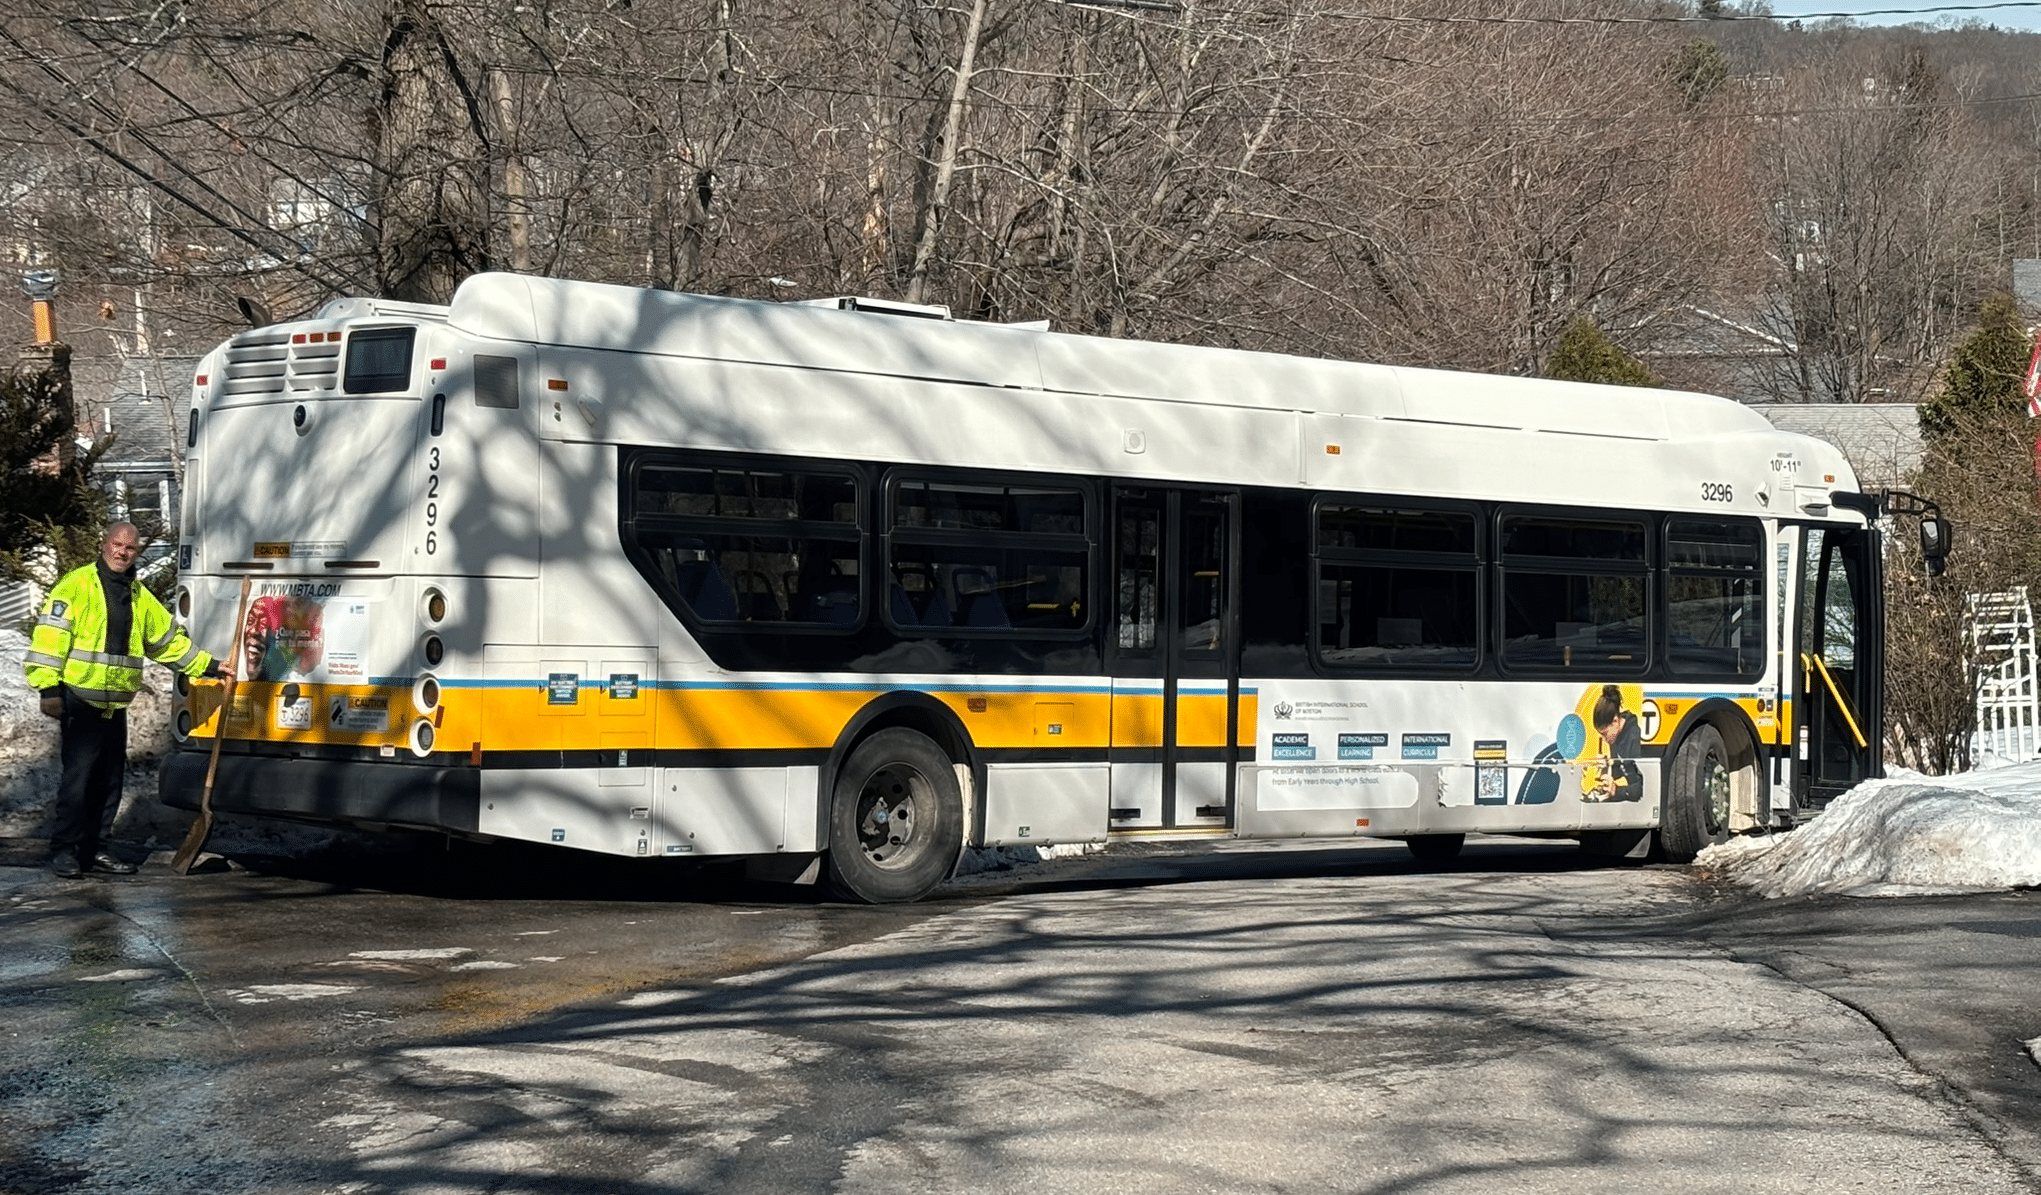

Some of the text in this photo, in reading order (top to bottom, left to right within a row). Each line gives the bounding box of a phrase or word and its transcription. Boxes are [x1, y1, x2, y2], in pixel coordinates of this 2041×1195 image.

[1701, 482, 1733, 503] 3296
[426, 446, 440, 556] 3296
[260, 583, 342, 597] WWW.MBTA.COM
[355, 698, 388, 708] CAUTION
[290, 707, 309, 722] 3296
[1642, 711, 1656, 735] T
[1273, 736, 1307, 744] ACADEMIC
[1339, 736, 1385, 744] PERSONALIZED
[1403, 736, 1449, 744] INTERNATIONAL
[1272, 749, 1312, 757] EXCELLENCE
[1340, 749, 1371, 757] LEARNING
[1402, 749, 1436, 757] CURRICULA
[1288, 778, 1303, 786] Early
[1320, 778, 1344, 786] through
[1344, 778, 1358, 786] High
